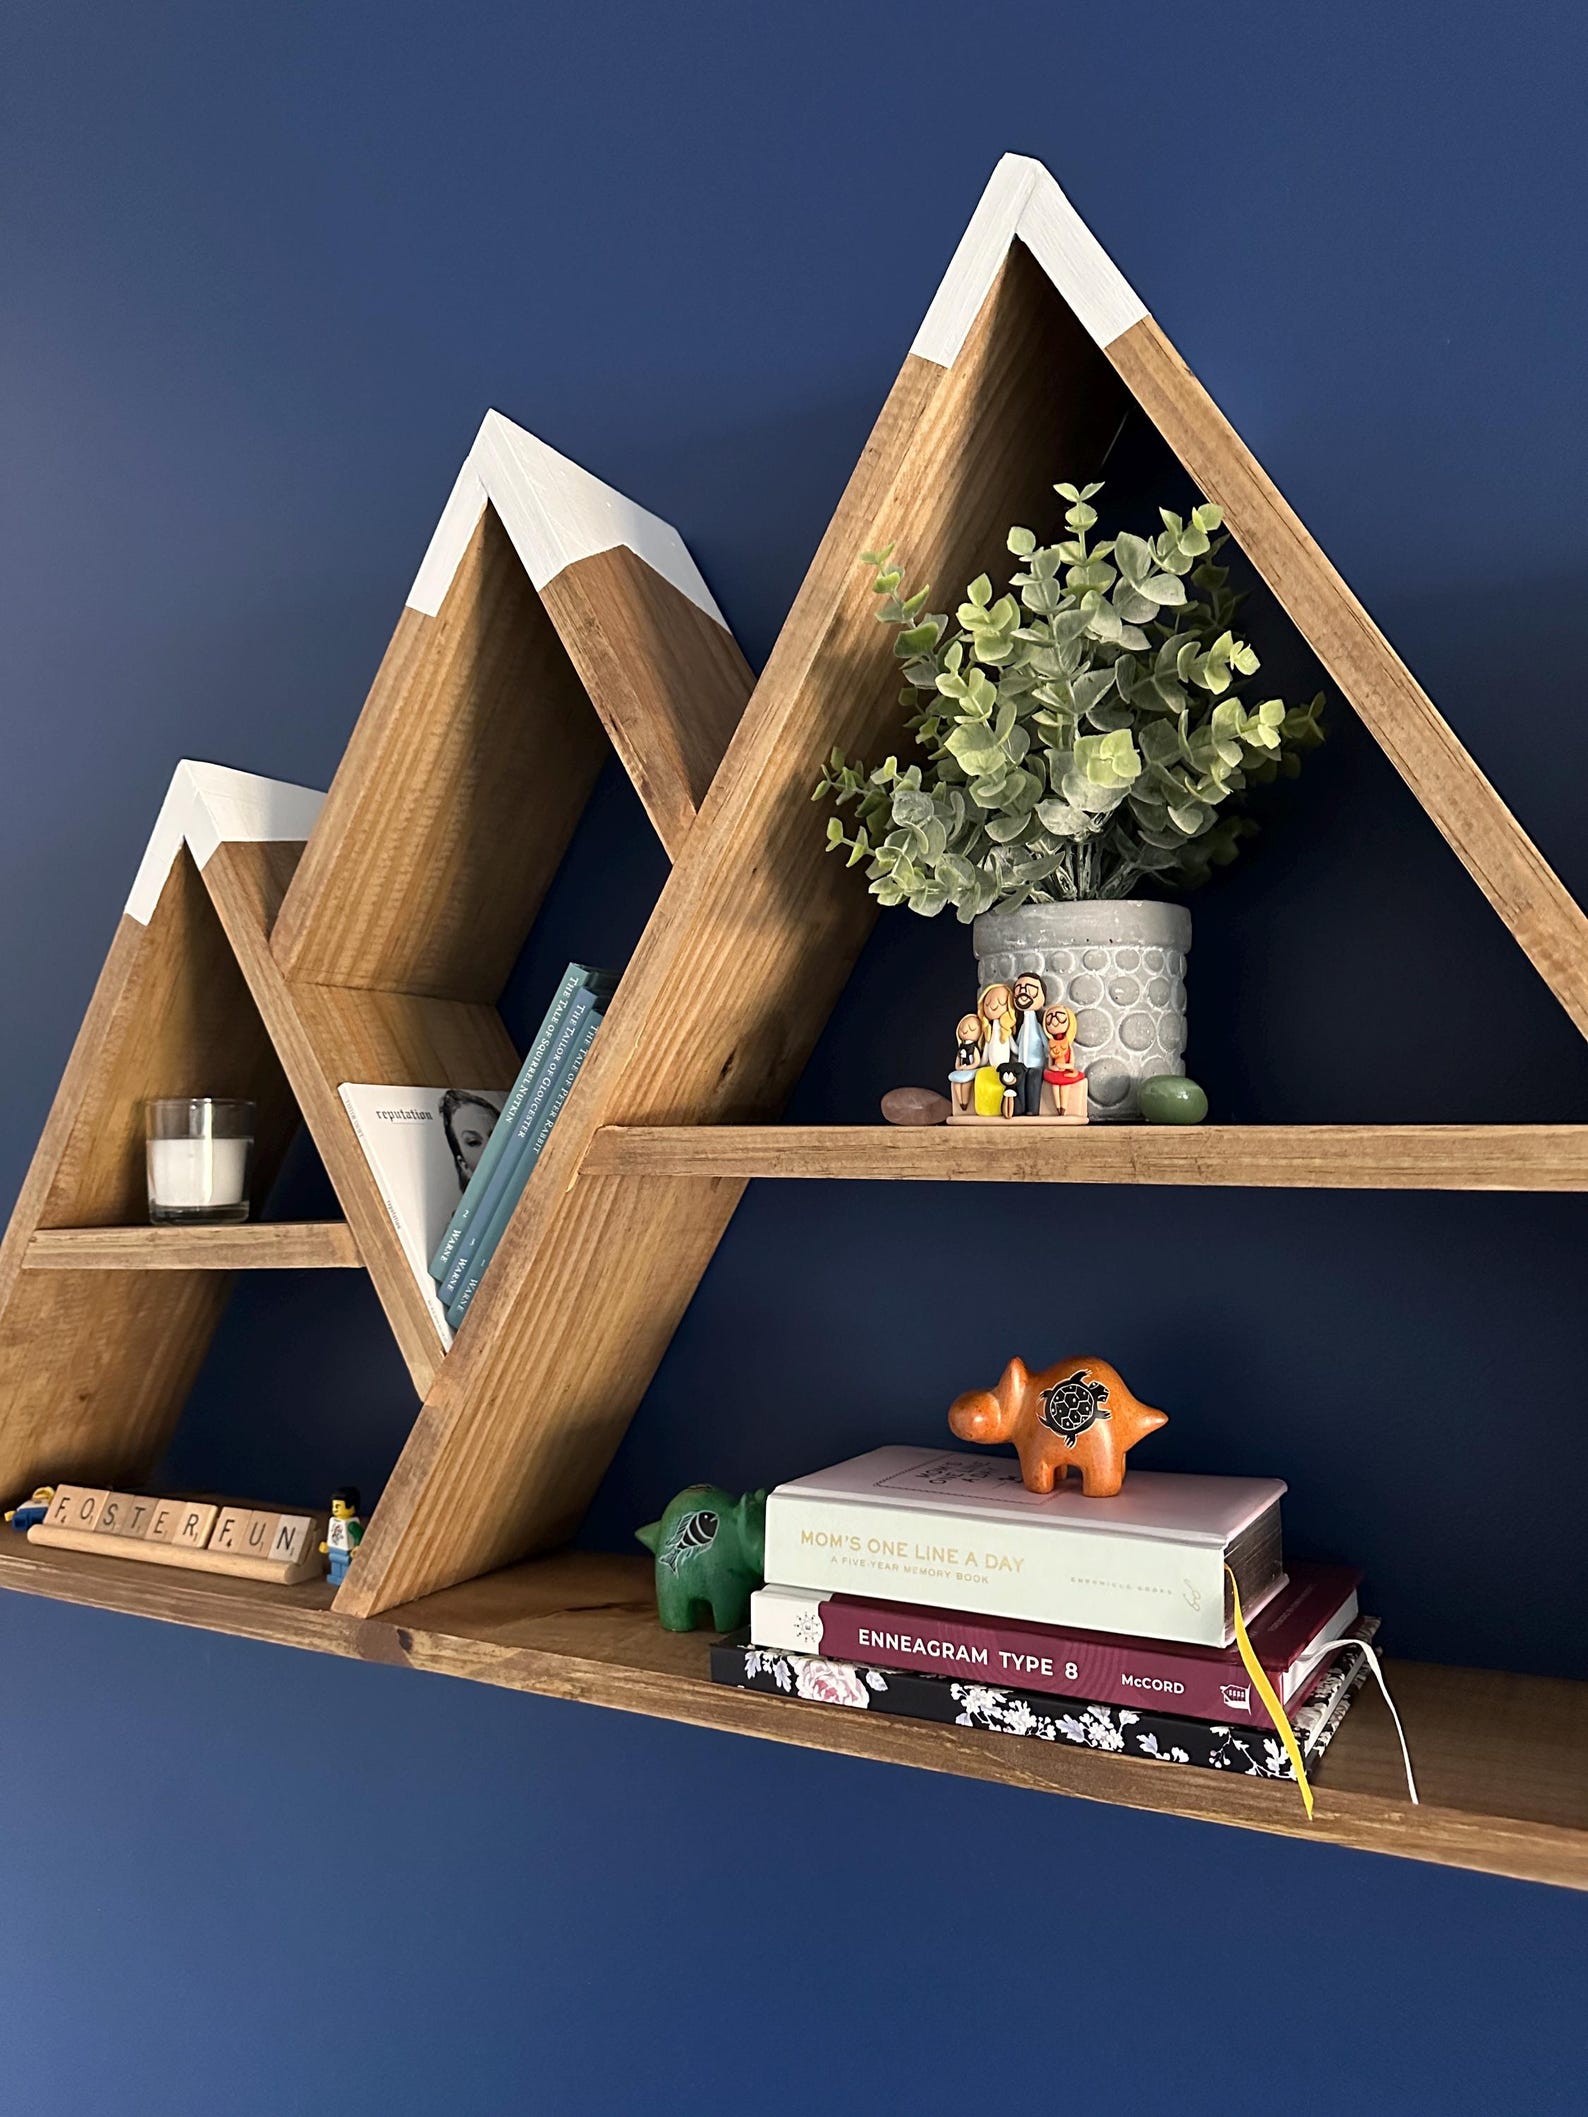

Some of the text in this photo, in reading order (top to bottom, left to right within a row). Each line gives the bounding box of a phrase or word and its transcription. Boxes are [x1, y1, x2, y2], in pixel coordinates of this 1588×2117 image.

[505, 977, 579, 1123] THE TALE OF SQUIRREL NUTKIN
[517, 1004, 586, 1138] THE TAILOR OF GLOUCESTER
[532, 1025, 598, 1154] THE TALE OF PETER RABBIT
[375, 1108, 434, 1122] reputation
[463, 1209, 470, 1218] 2
[440, 1229, 462, 1263] WARNE
[446, 1258, 468, 1292] WARNE
[456, 1278, 479, 1312] WARNE
[54, 1497, 297, 1550] FOSTER FUN
[801, 1529, 1025, 1573] MOM'S ONE LINE A DAY
[830, 1556, 989, 1584] A FIVE-YEAR MEMORY BOOK
[858, 1628, 1080, 1681] ENNEAGRAM TYPE 8
[1121, 1673, 1186, 1695] McCORD
